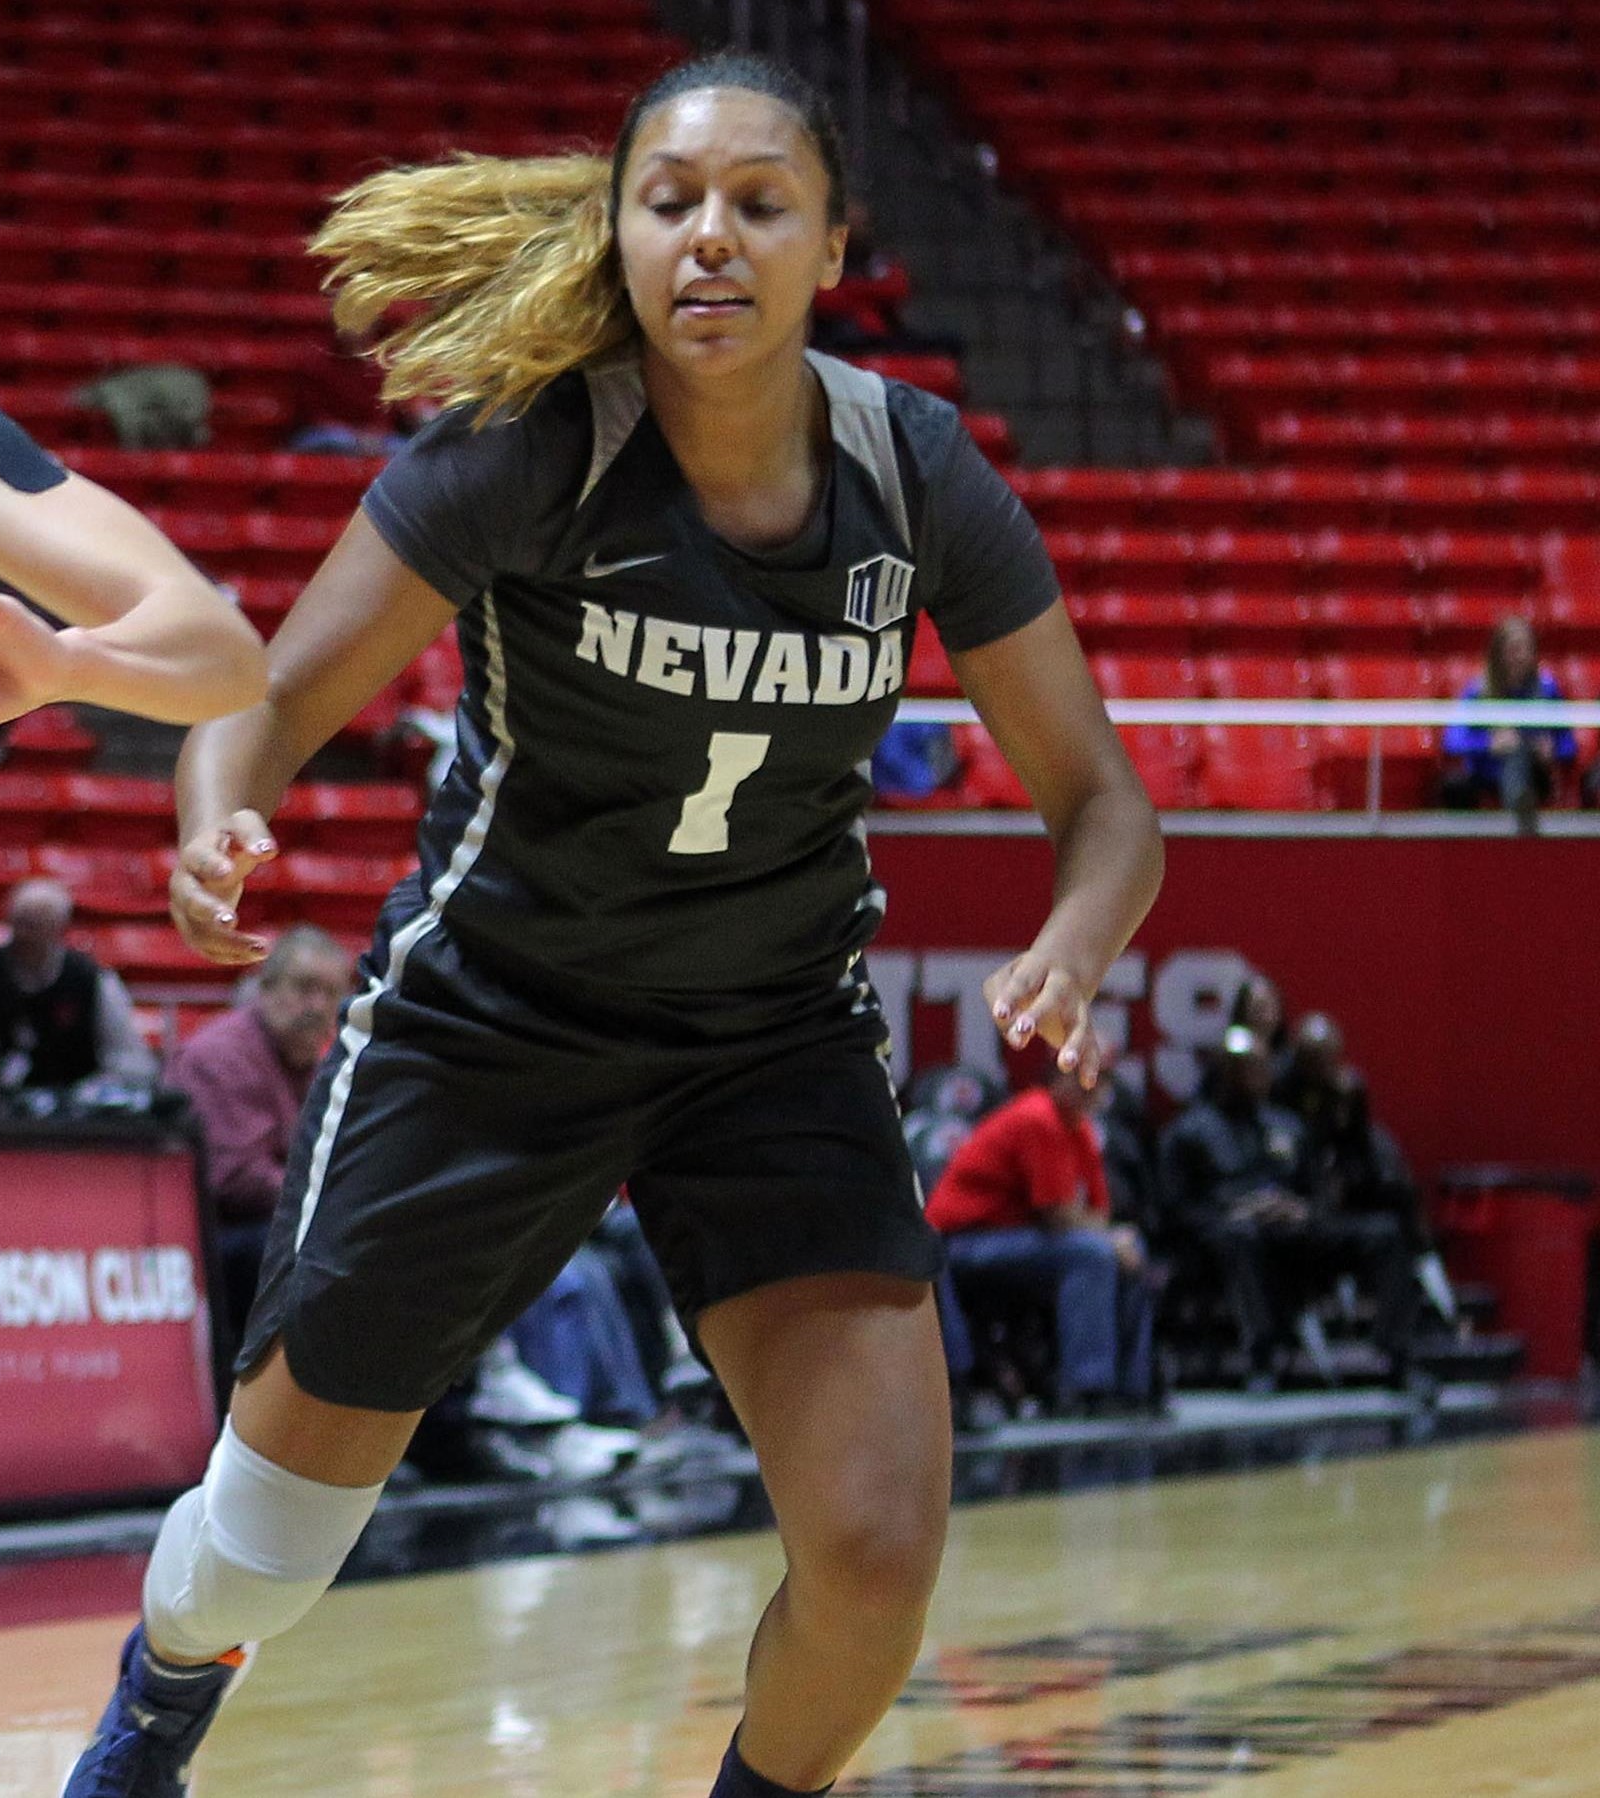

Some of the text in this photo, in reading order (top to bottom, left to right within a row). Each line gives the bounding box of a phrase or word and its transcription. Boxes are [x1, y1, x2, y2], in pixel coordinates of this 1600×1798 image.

[575, 600, 904, 706] NEVADA
[667, 731, 772, 854] 1
[94, 1246, 196, 1323] CLUB
